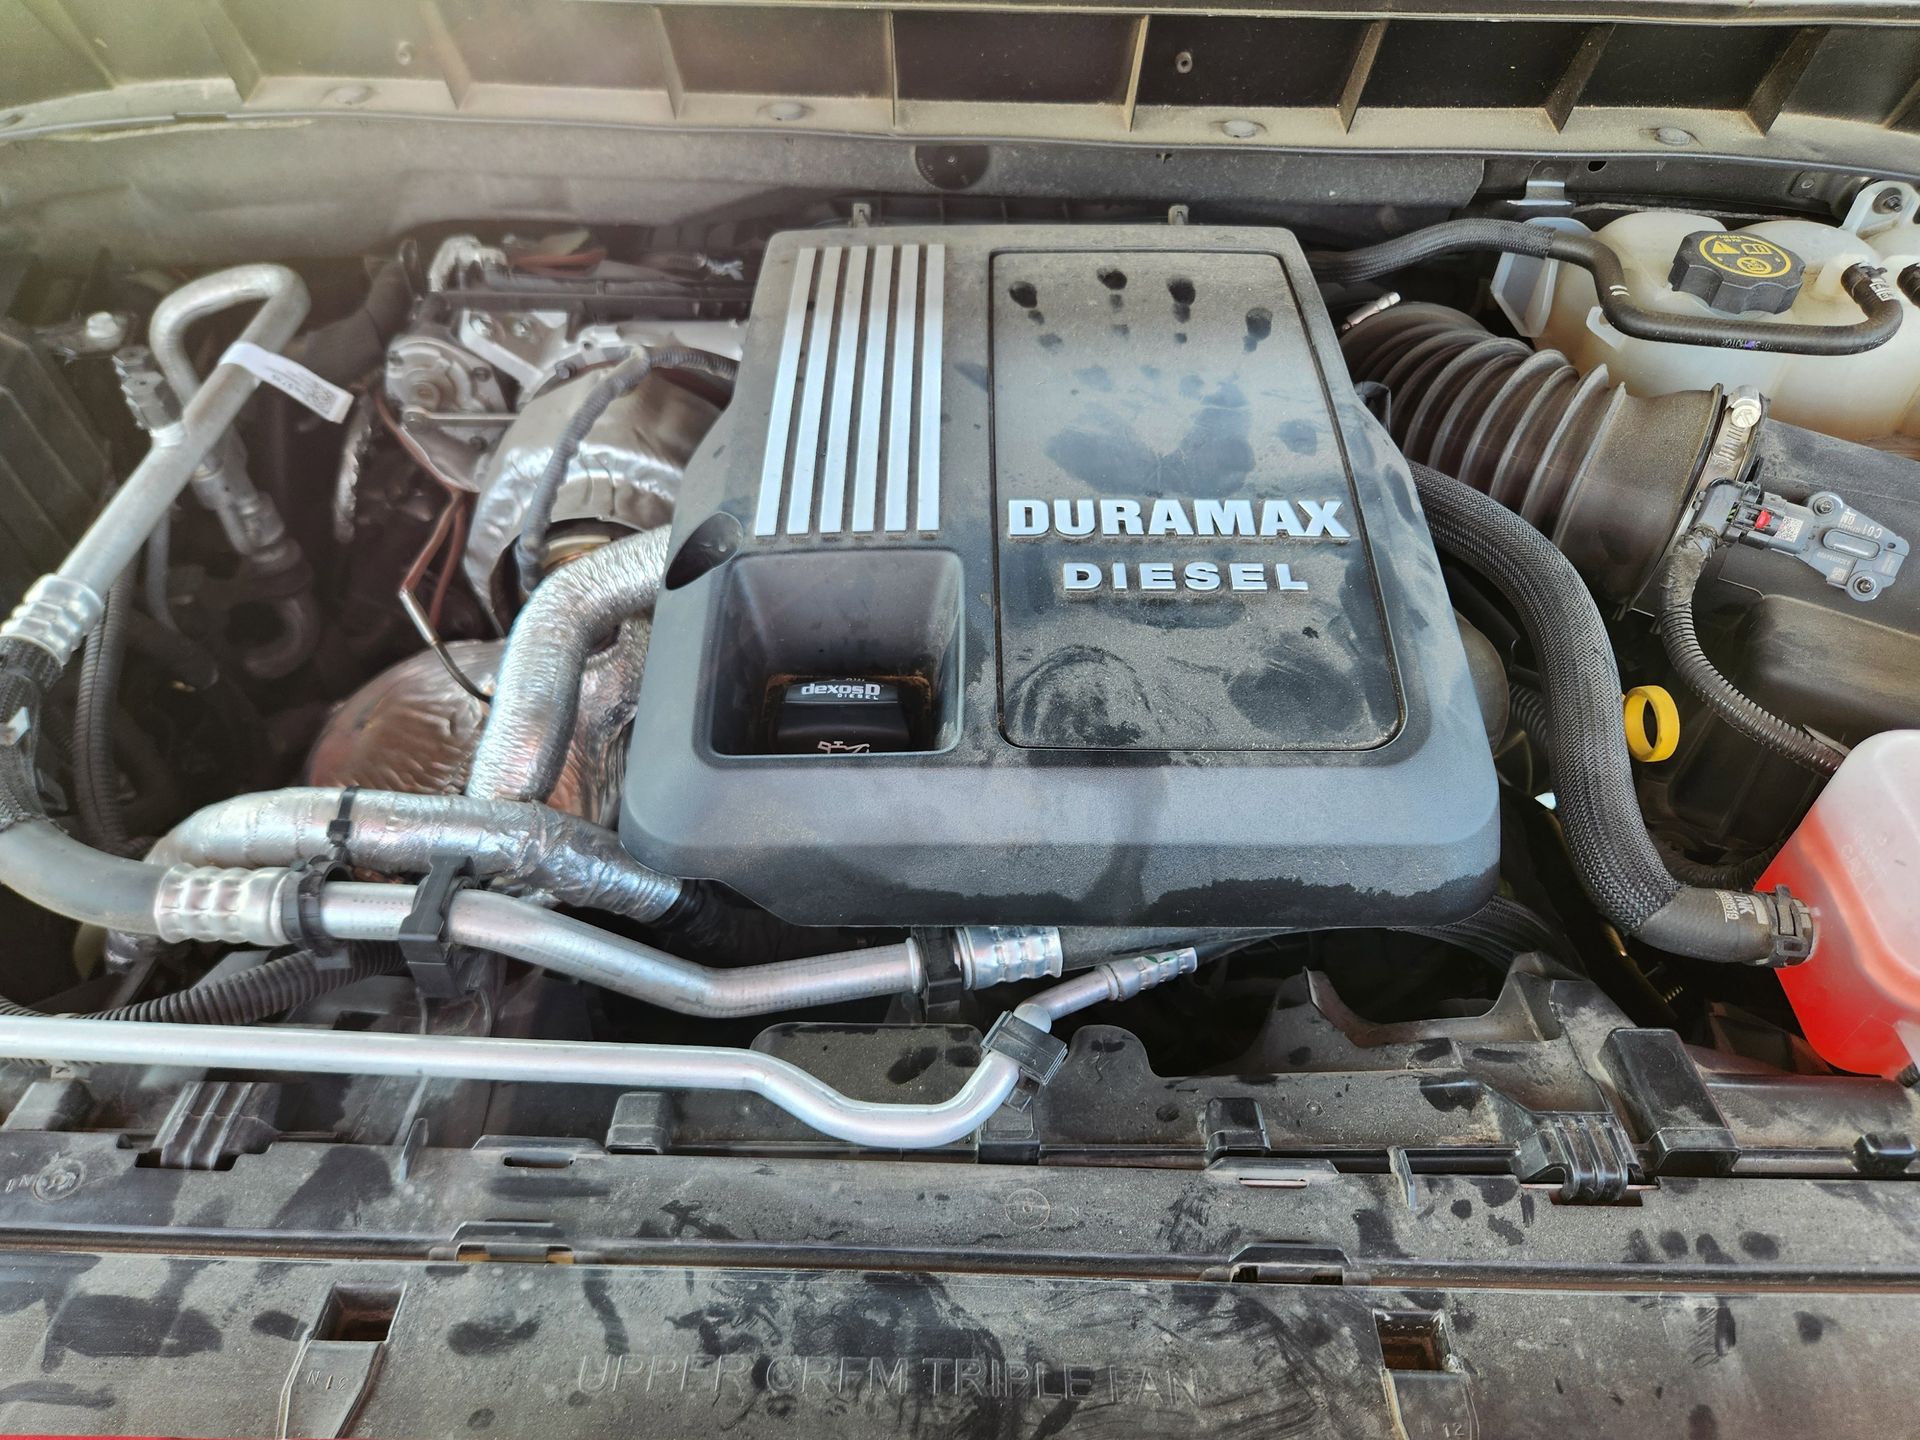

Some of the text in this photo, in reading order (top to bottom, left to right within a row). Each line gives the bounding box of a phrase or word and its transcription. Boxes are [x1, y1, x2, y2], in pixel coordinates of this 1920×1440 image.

[1008, 499, 1351, 538] DURAMAX
[1063, 562, 1309, 593] DIESEL
[922, 1357, 1092, 1401] TRIPLE
